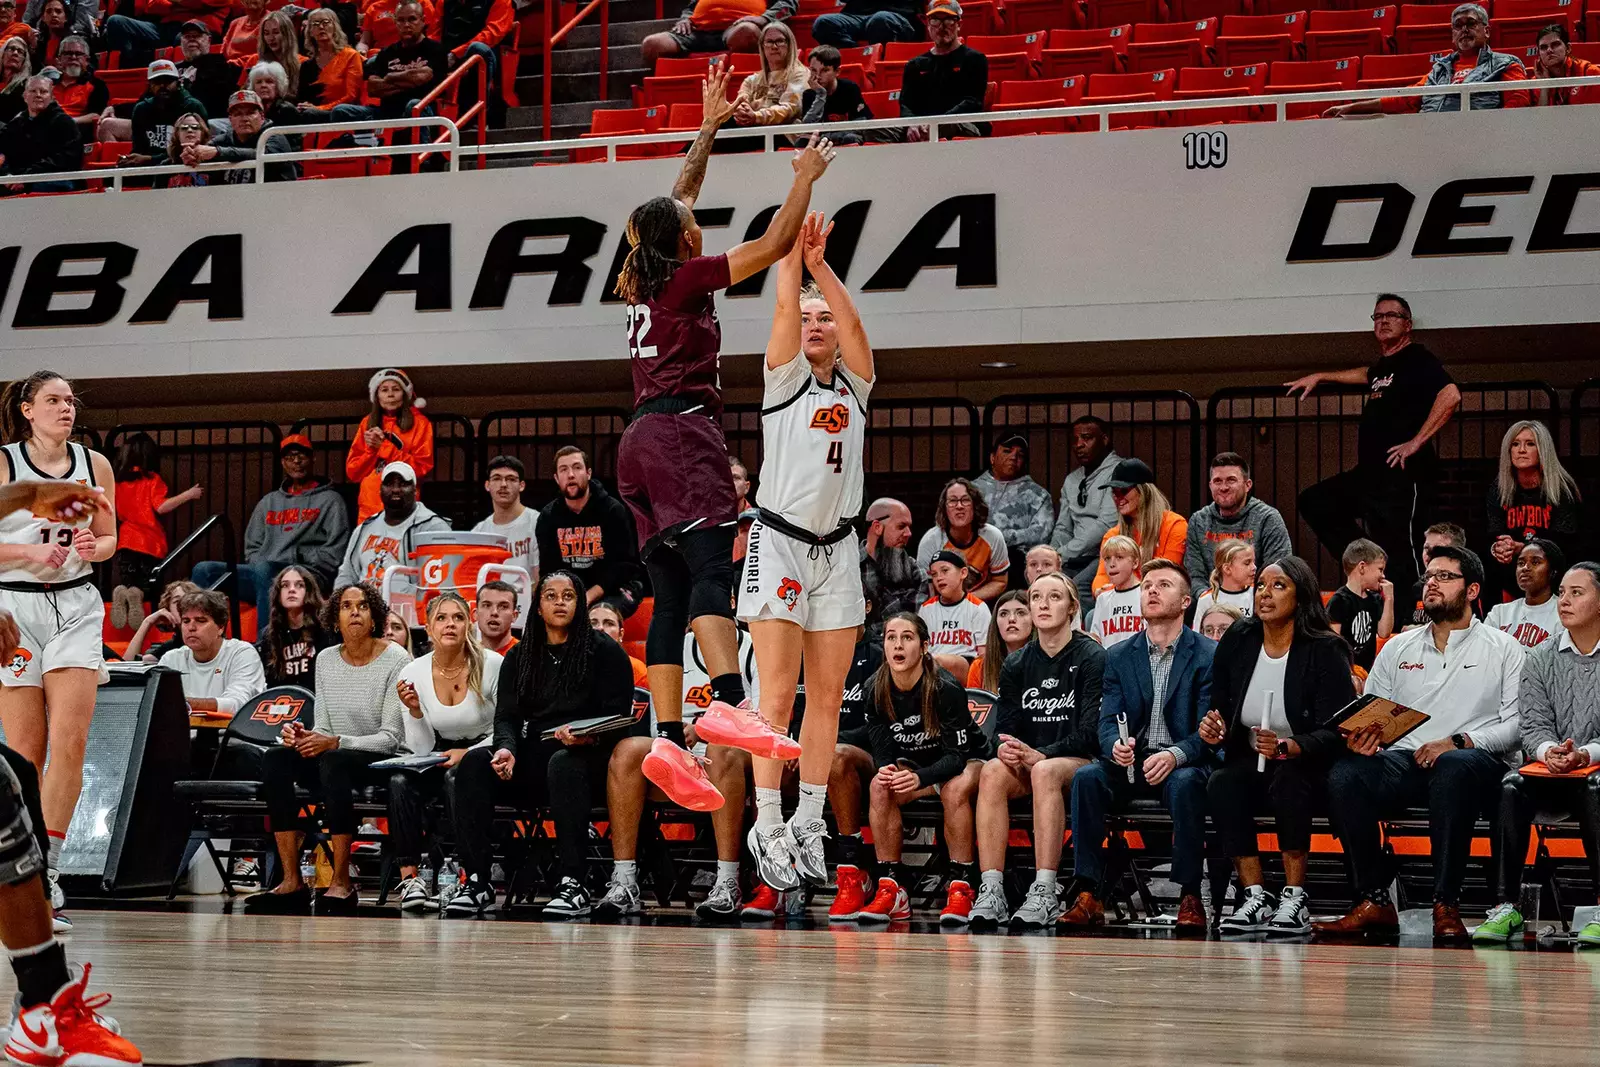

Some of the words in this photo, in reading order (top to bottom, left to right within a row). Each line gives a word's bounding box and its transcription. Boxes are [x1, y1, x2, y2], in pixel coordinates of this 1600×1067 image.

[1183, 131, 1228, 169] 109
[826, 441, 843, 473] 4
[423, 559, 443, 584] G
[746, 523, 764, 594] COWGIRLS
[685, 683, 713, 708] OS
[956, 729, 968, 746] 15
